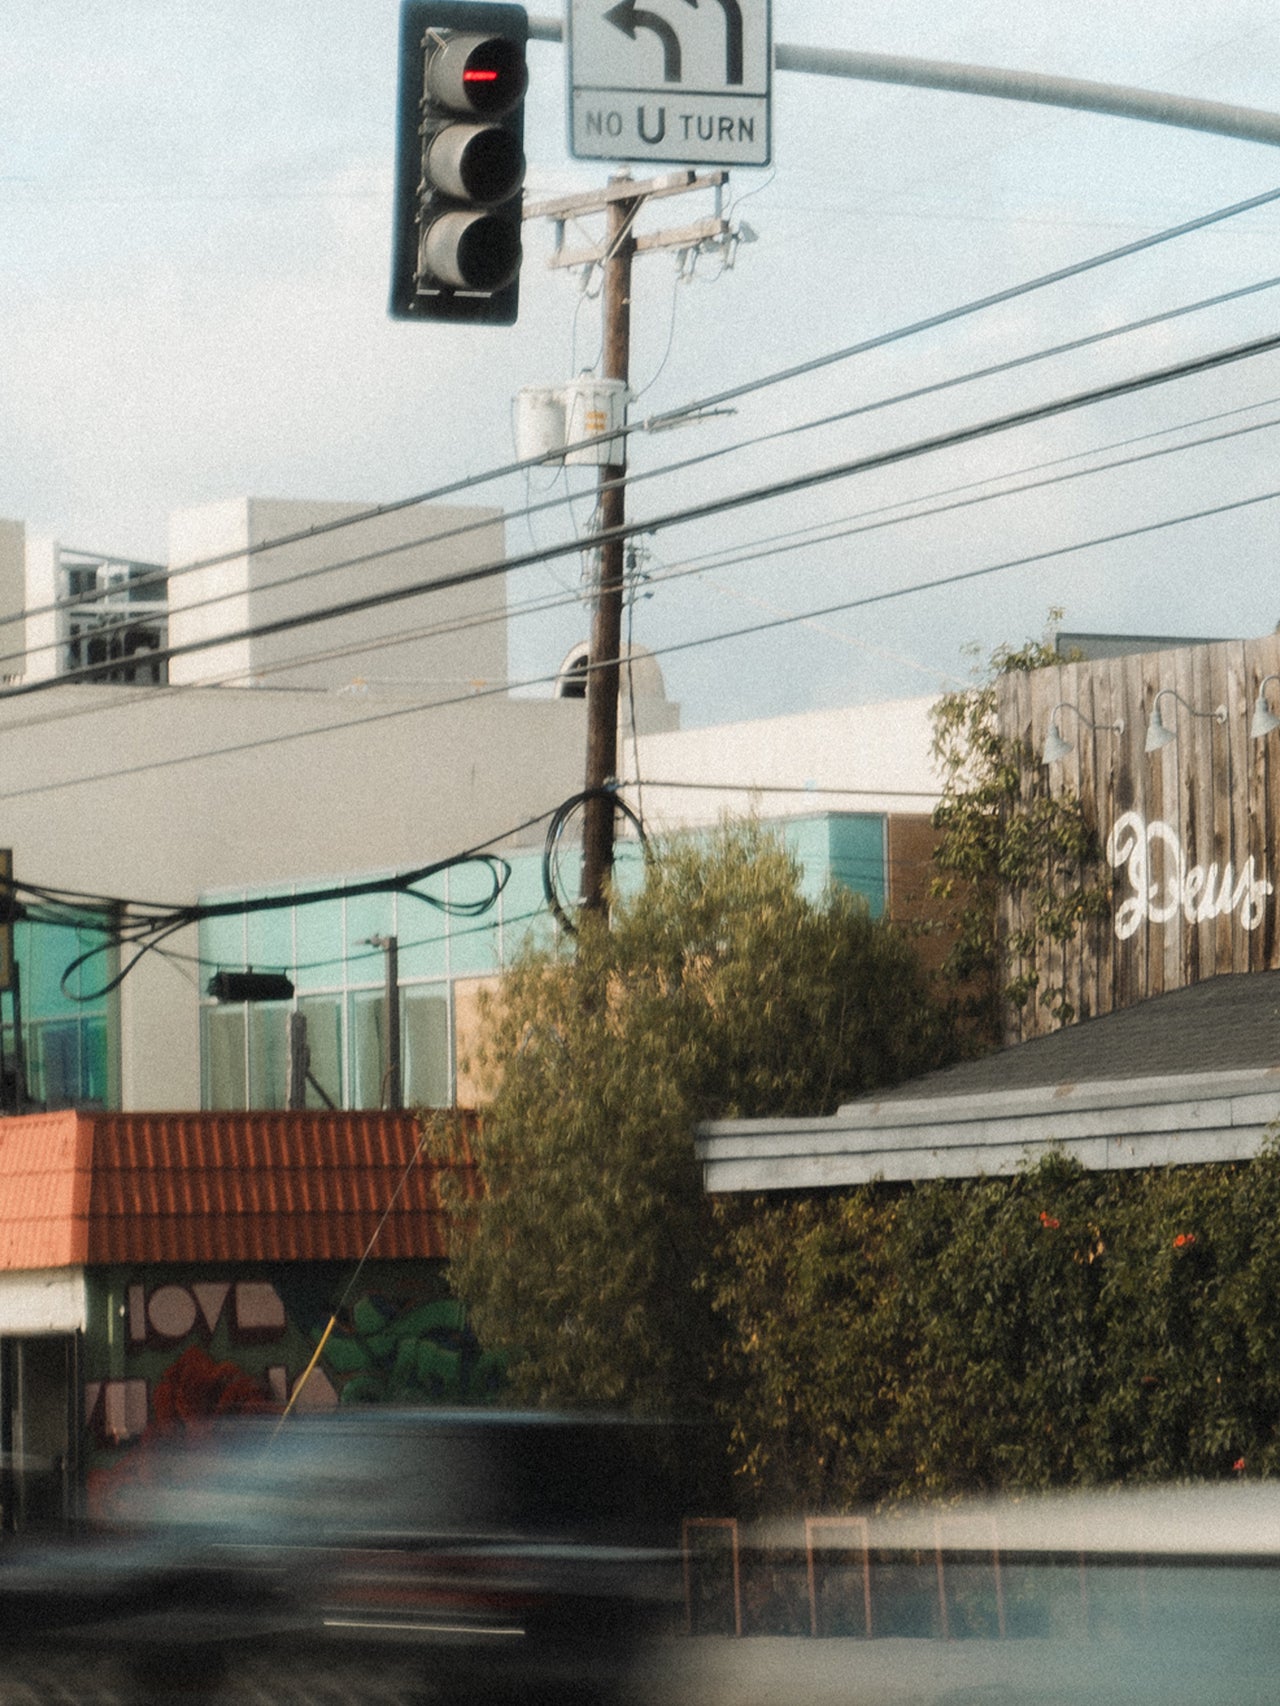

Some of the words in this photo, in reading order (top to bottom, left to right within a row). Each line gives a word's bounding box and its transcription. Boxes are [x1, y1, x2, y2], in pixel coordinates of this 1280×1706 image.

[587, 111, 622, 137] NO
[637, 107, 665, 144] U
[679, 115, 754, 142] TURN
[1107, 811, 1273, 940] Deus
